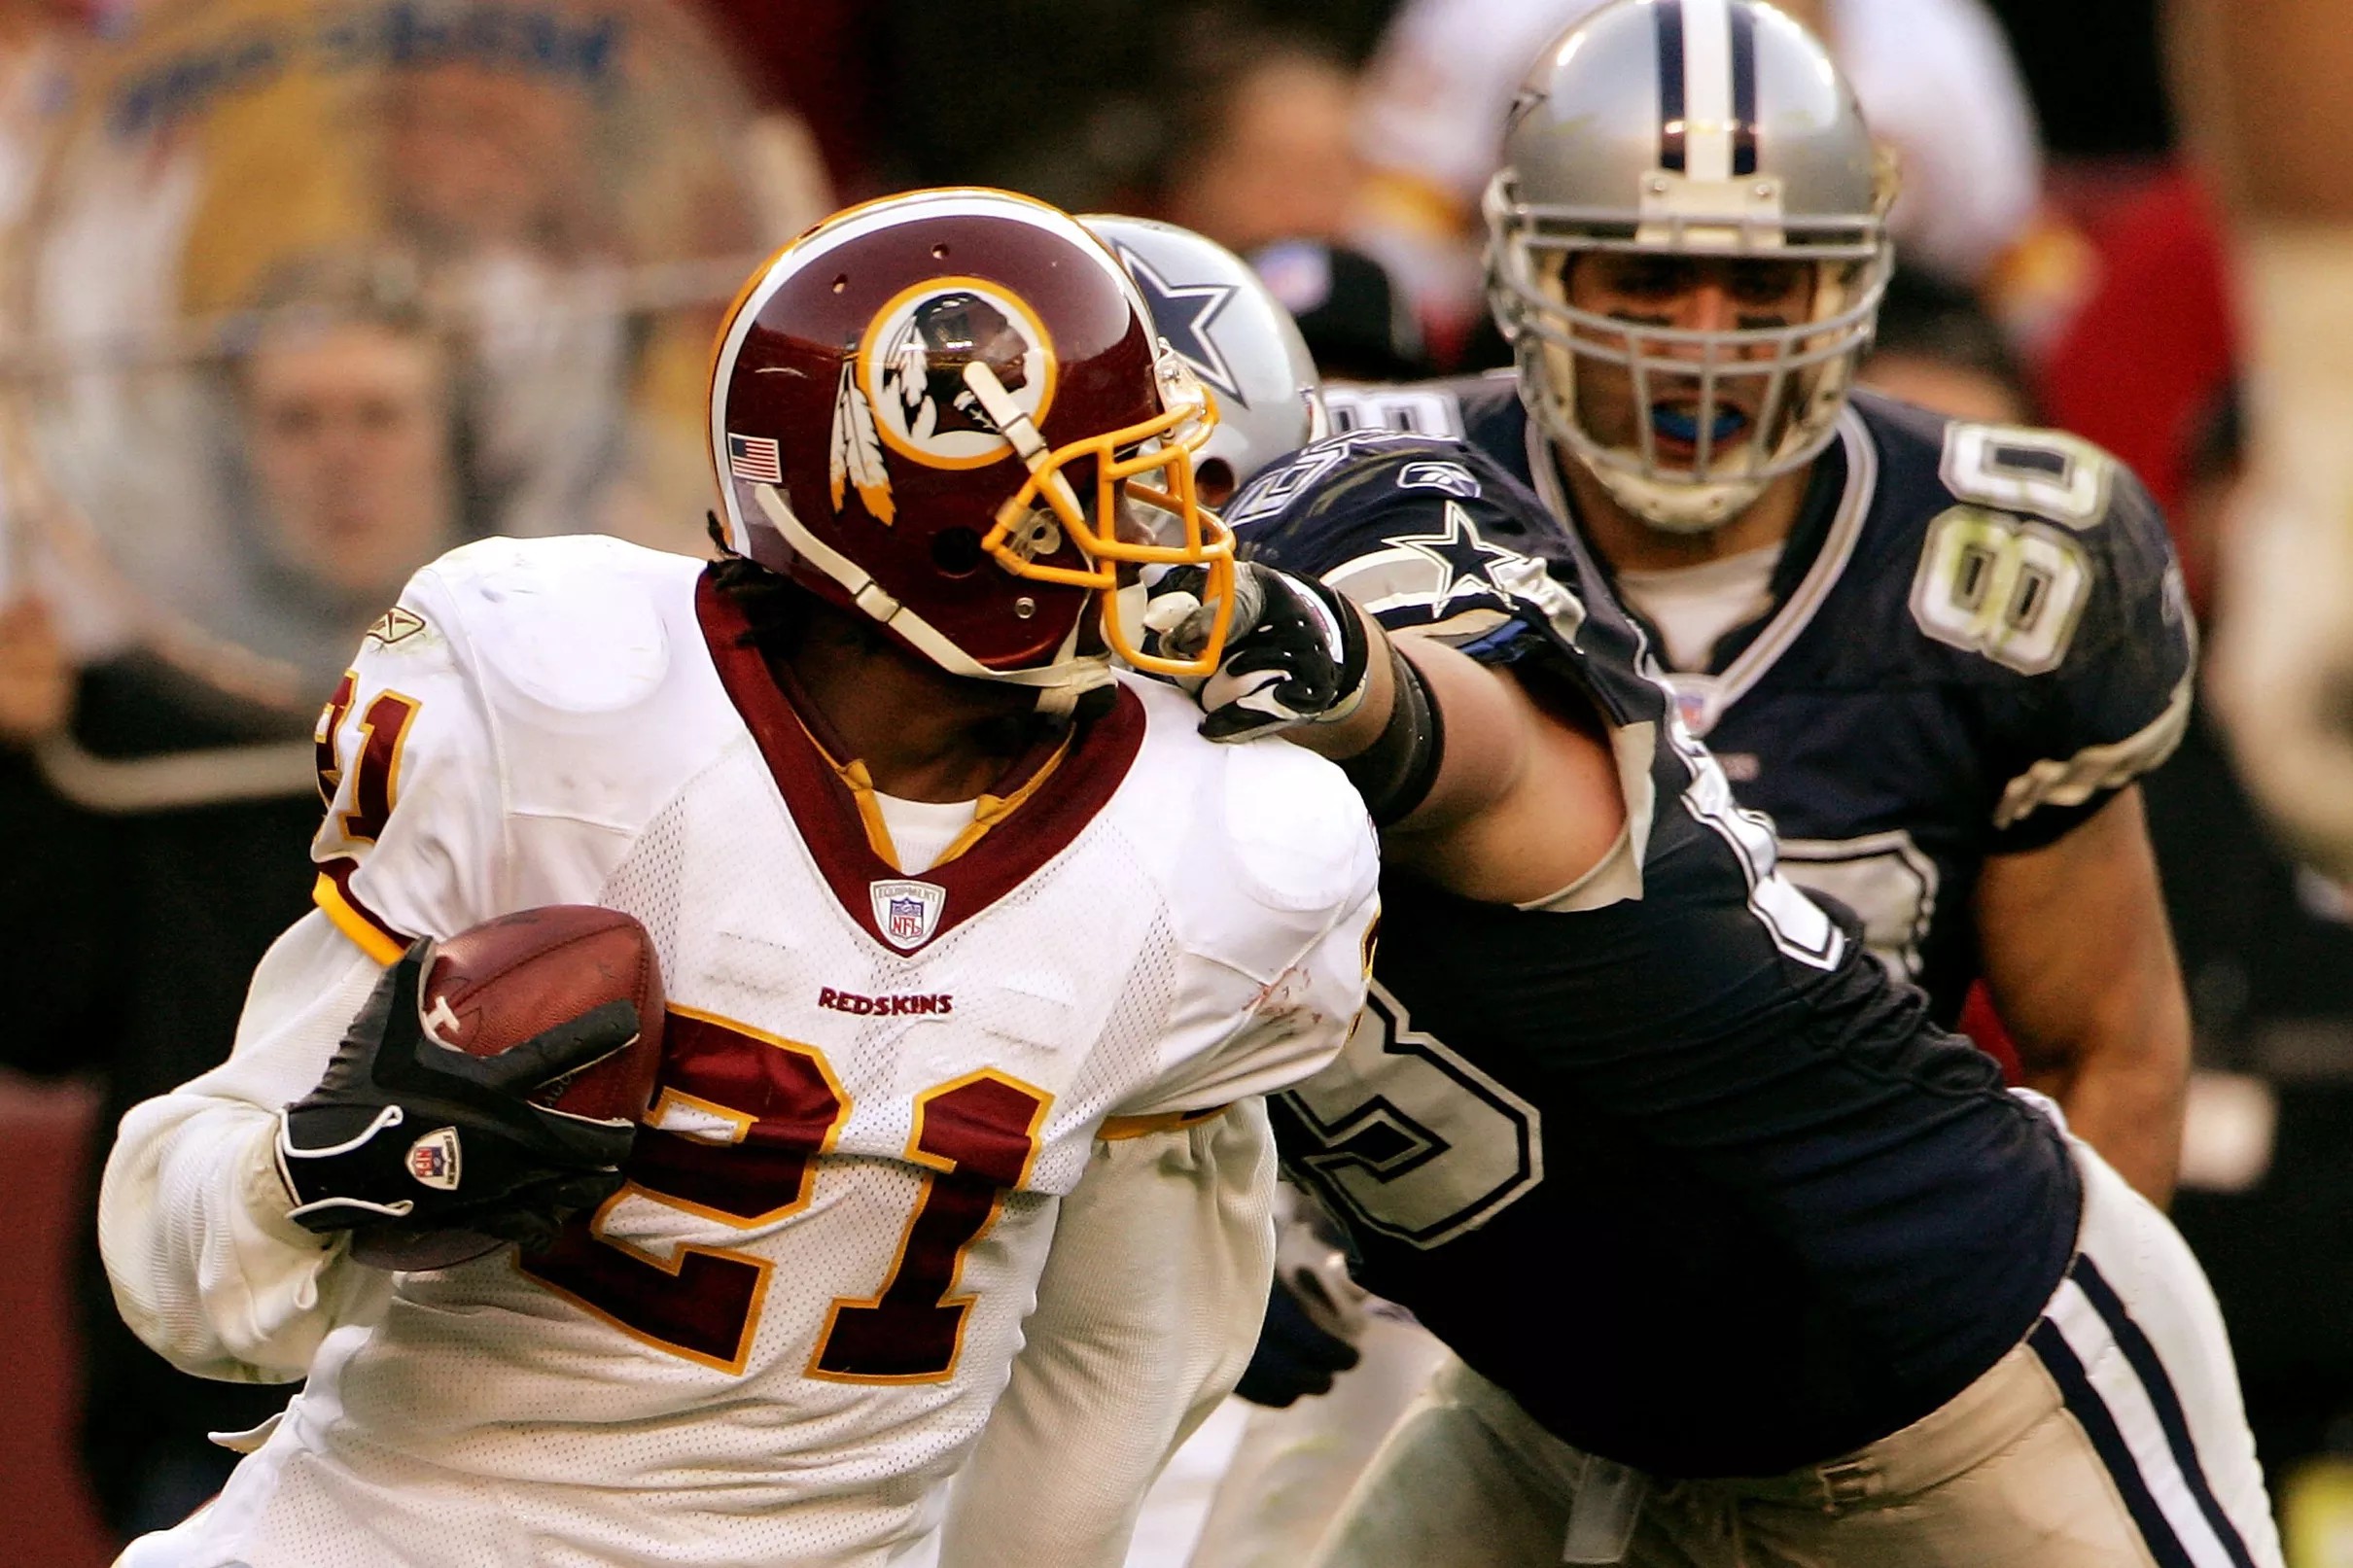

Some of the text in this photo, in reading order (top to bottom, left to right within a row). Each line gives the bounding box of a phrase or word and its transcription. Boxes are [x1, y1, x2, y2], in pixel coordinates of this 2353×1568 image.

[1908, 420, 2116, 678] 80
[891, 916, 923, 937] NFL
[818, 986, 954, 1017] REDSKINS
[511, 1001, 1057, 1386] 21
